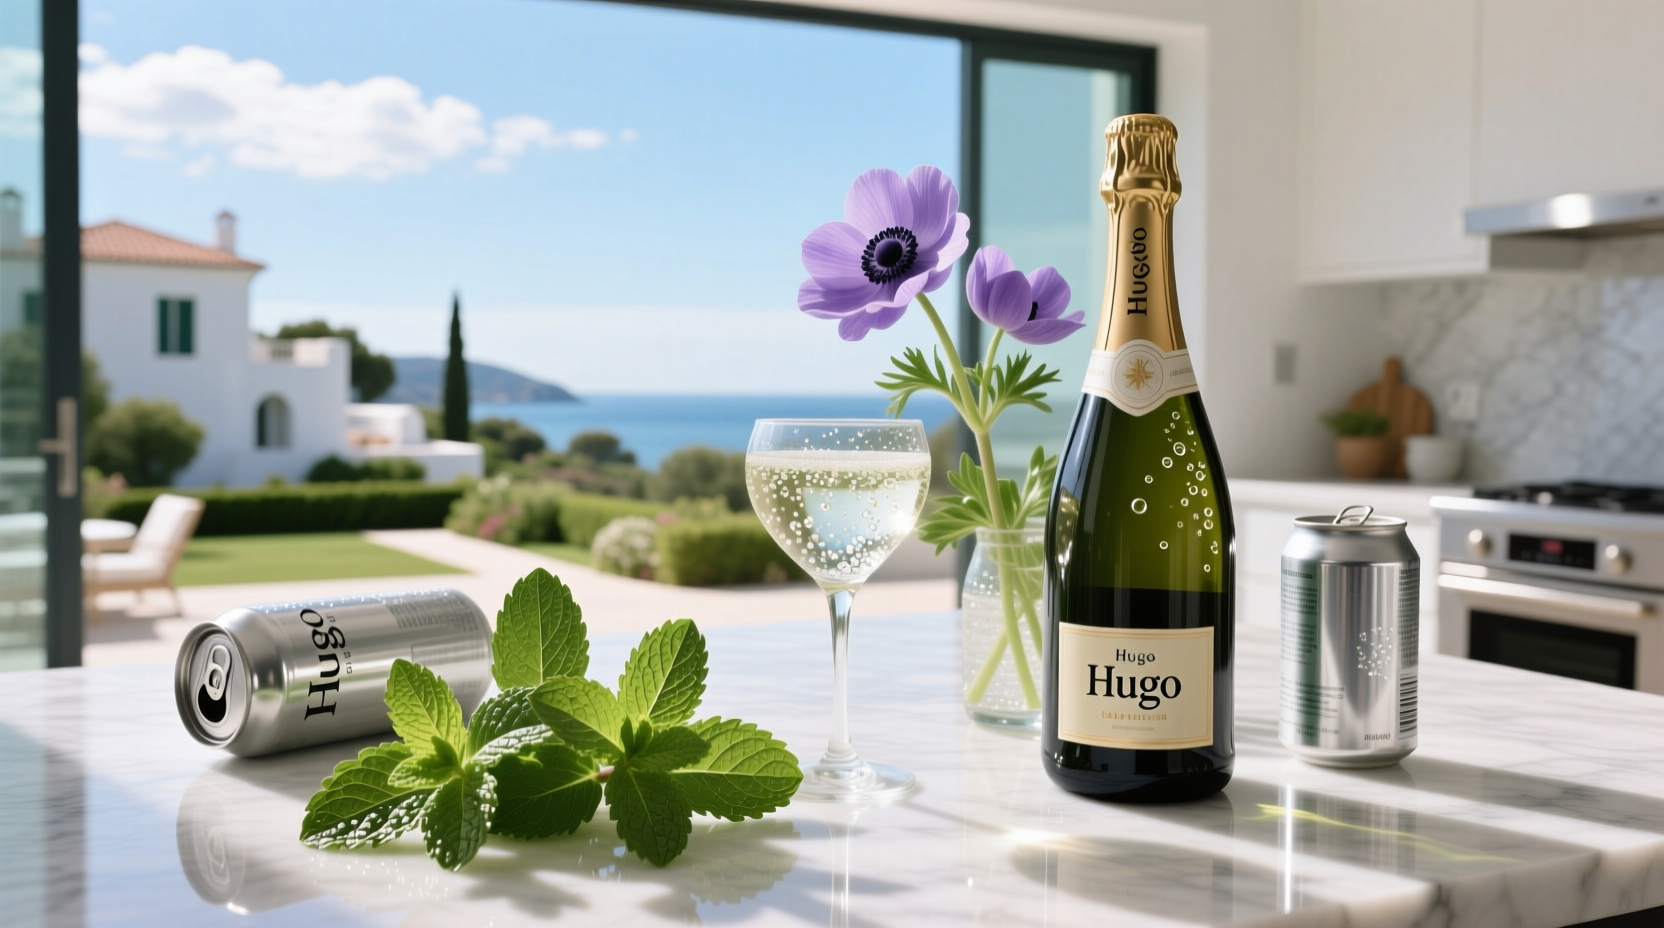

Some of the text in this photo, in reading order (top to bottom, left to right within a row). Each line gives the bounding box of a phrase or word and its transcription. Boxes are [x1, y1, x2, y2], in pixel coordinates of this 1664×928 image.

[299, 608, 346, 721] Hugo
[1115, 648, 1156, 666] Hugo
[1086, 664, 1182, 710] Hugo
